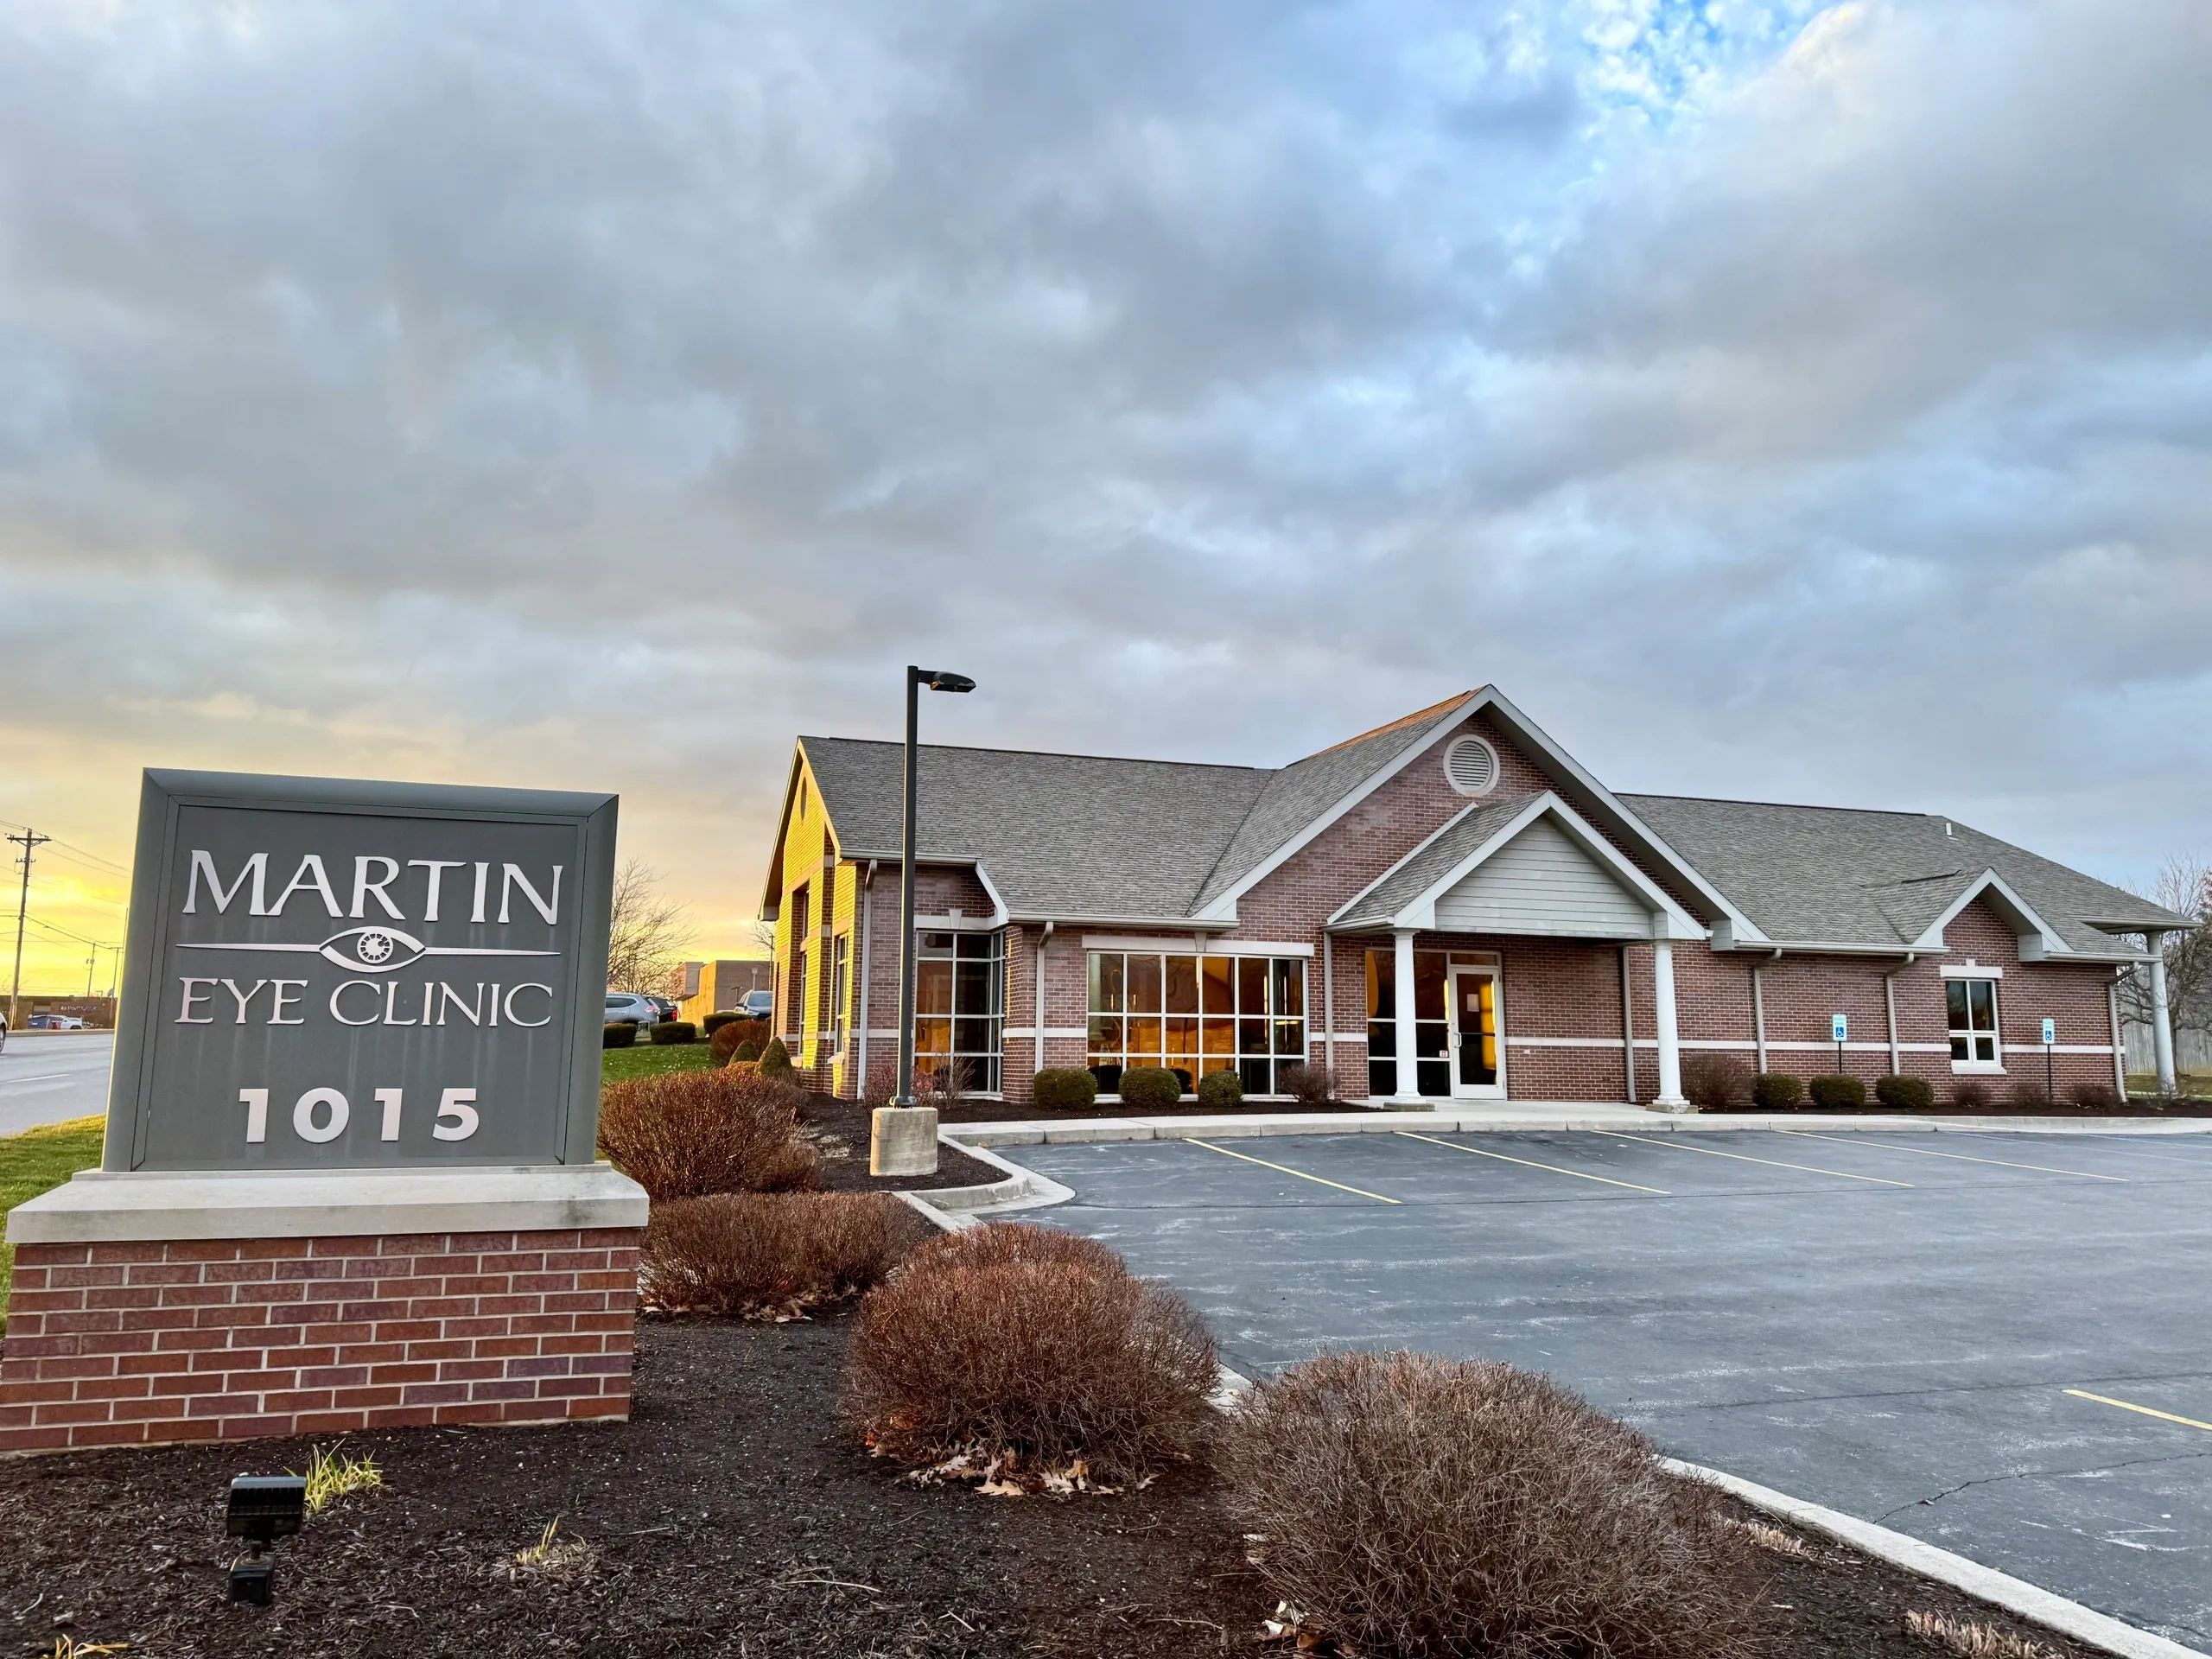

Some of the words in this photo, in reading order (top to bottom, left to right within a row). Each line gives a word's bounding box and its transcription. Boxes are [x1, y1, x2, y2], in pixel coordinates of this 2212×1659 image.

[182, 849, 563, 925] MARTIN
[174, 977, 308, 1025] EYE
[329, 980, 553, 1027] CLINIC
[238, 1087, 480, 1143] 1015
